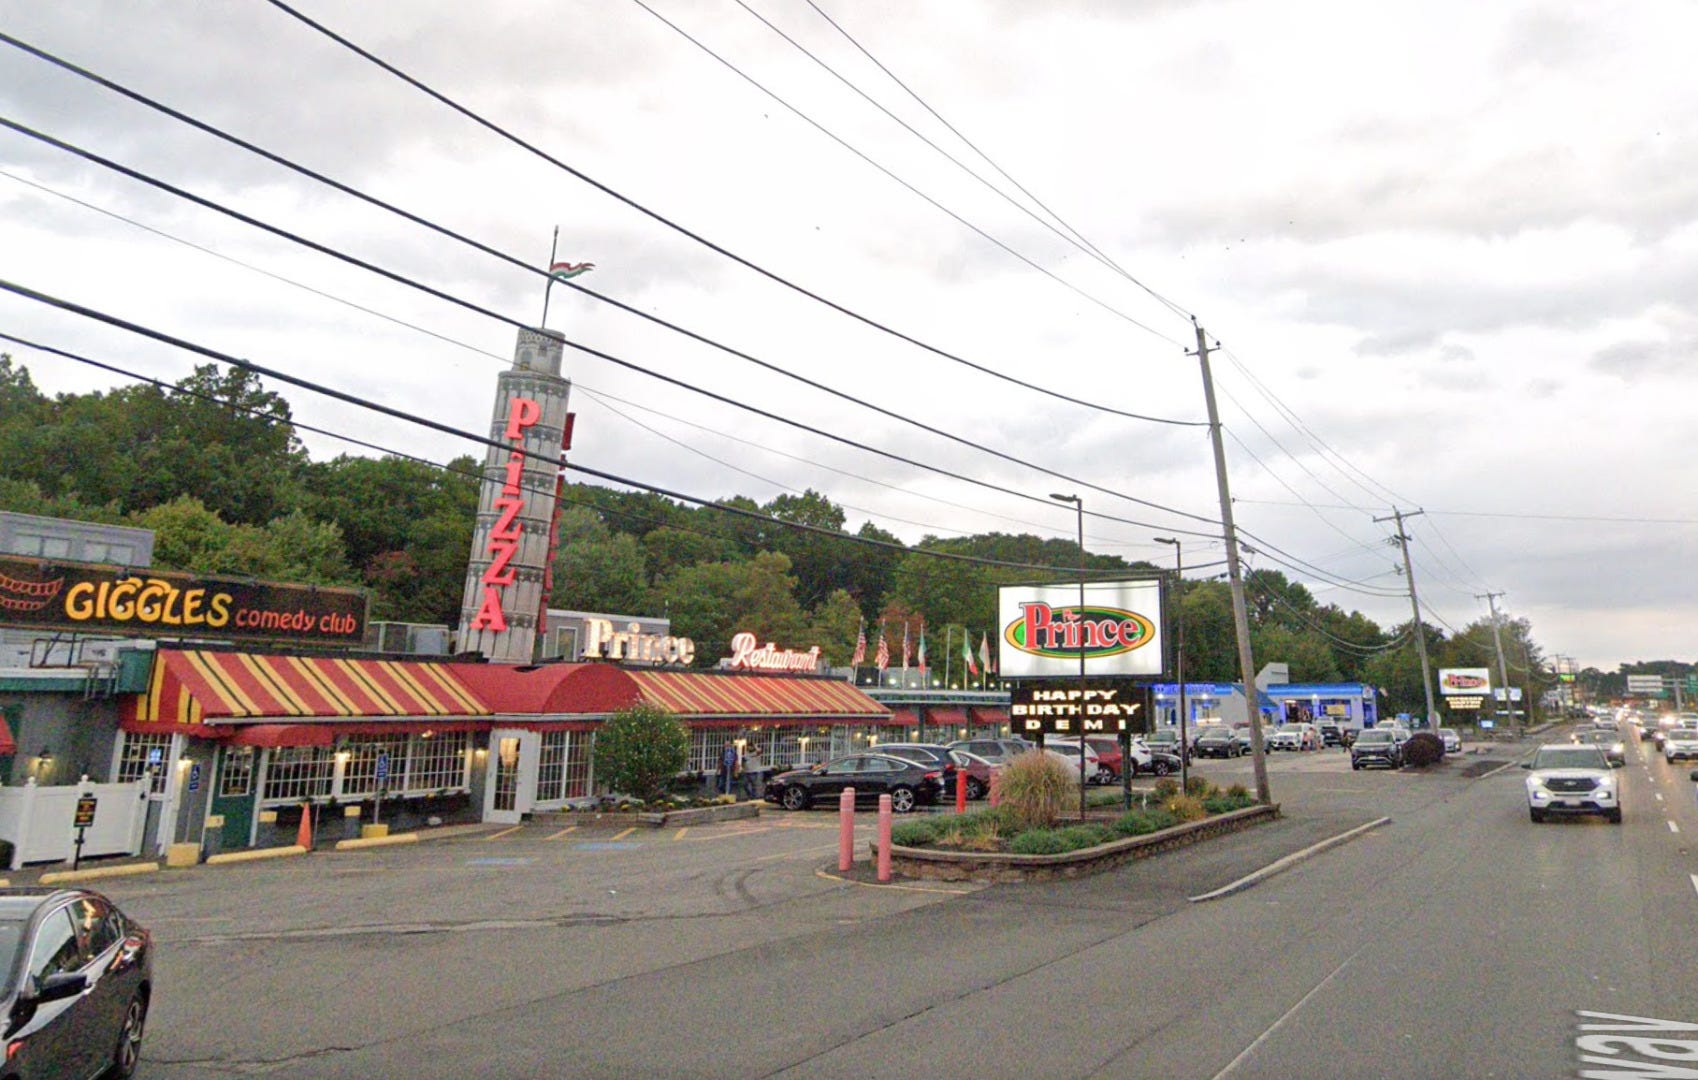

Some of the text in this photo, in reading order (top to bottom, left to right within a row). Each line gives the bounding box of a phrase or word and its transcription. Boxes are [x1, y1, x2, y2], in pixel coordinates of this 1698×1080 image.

[65, 578, 356, 634] GIGGLES comedy club
[1019, 601, 1142, 650] Prince
[580, 618, 820, 672] Prince Restaurant
[1033, 690, 1118, 701] HAPPY
